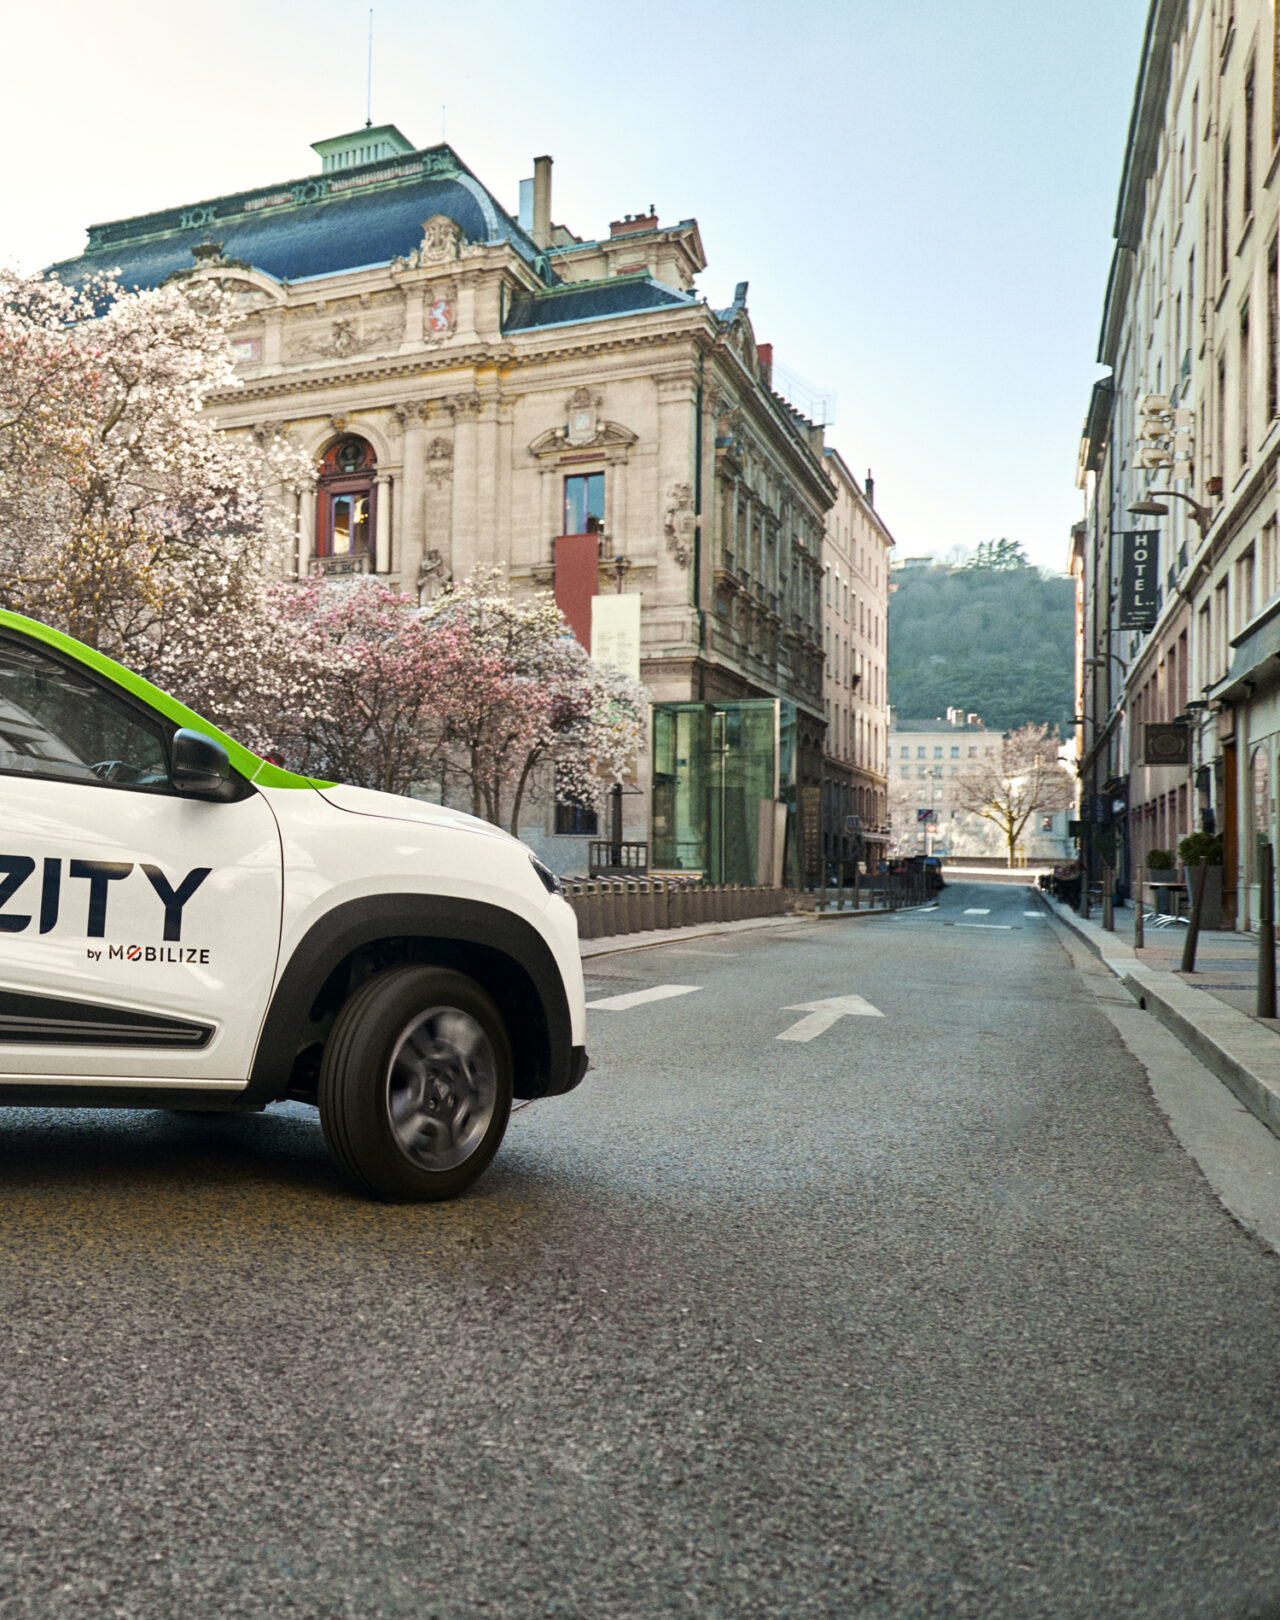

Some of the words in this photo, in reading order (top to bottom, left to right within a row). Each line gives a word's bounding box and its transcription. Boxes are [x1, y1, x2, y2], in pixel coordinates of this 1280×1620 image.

[1134, 534, 1148, 606] HOTEL
[87, 948, 102, 962] by
[108, 944, 211, 965] MOBILIZE
